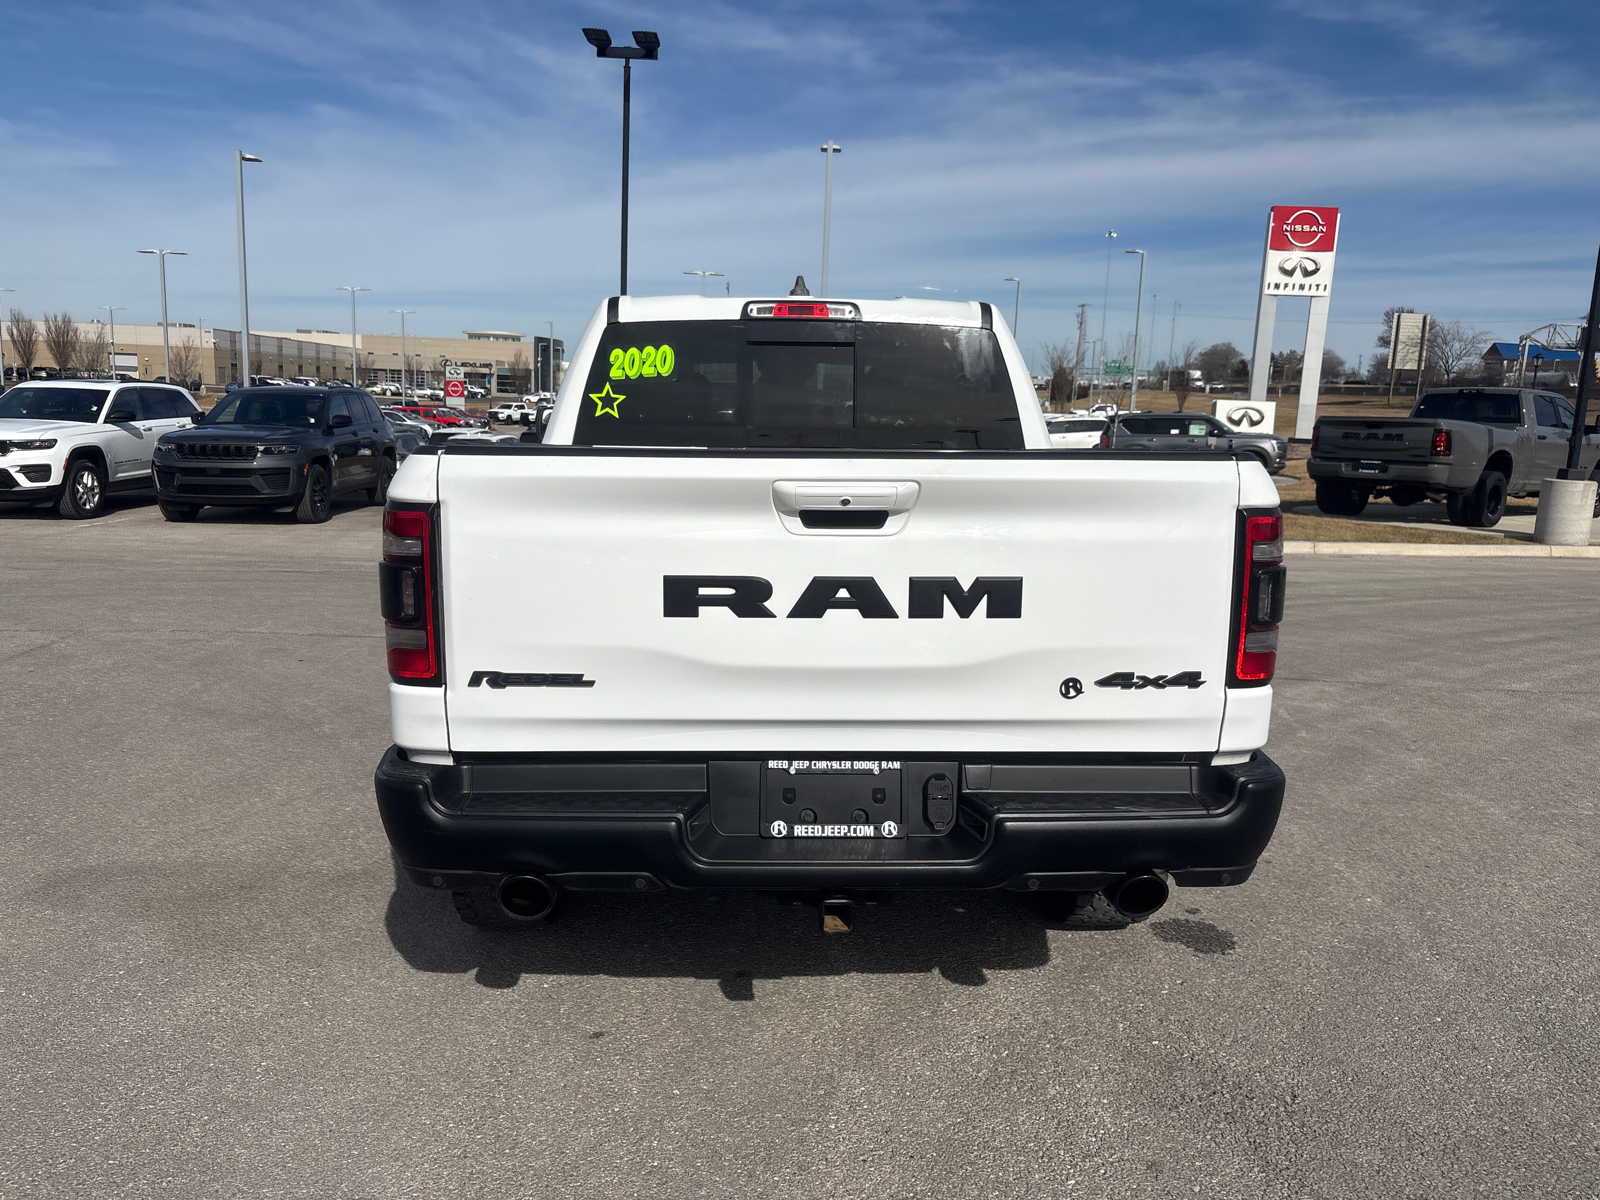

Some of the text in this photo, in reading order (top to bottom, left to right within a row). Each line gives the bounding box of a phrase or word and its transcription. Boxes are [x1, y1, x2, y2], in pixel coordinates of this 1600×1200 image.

[1267, 282, 1328, 292] INFINITI
[609, 344, 675, 380] 2020
[1342, 432, 1404, 441] RAM
[663, 575, 1023, 618] RAM
[467, 670, 596, 689] REBEL
[1094, 671, 1208, 690] 4x4
[768, 760, 901, 769] REED JEEP CHRYSLER DODGE RAM
[794, 825, 874, 837] REEDJEEP.COM
